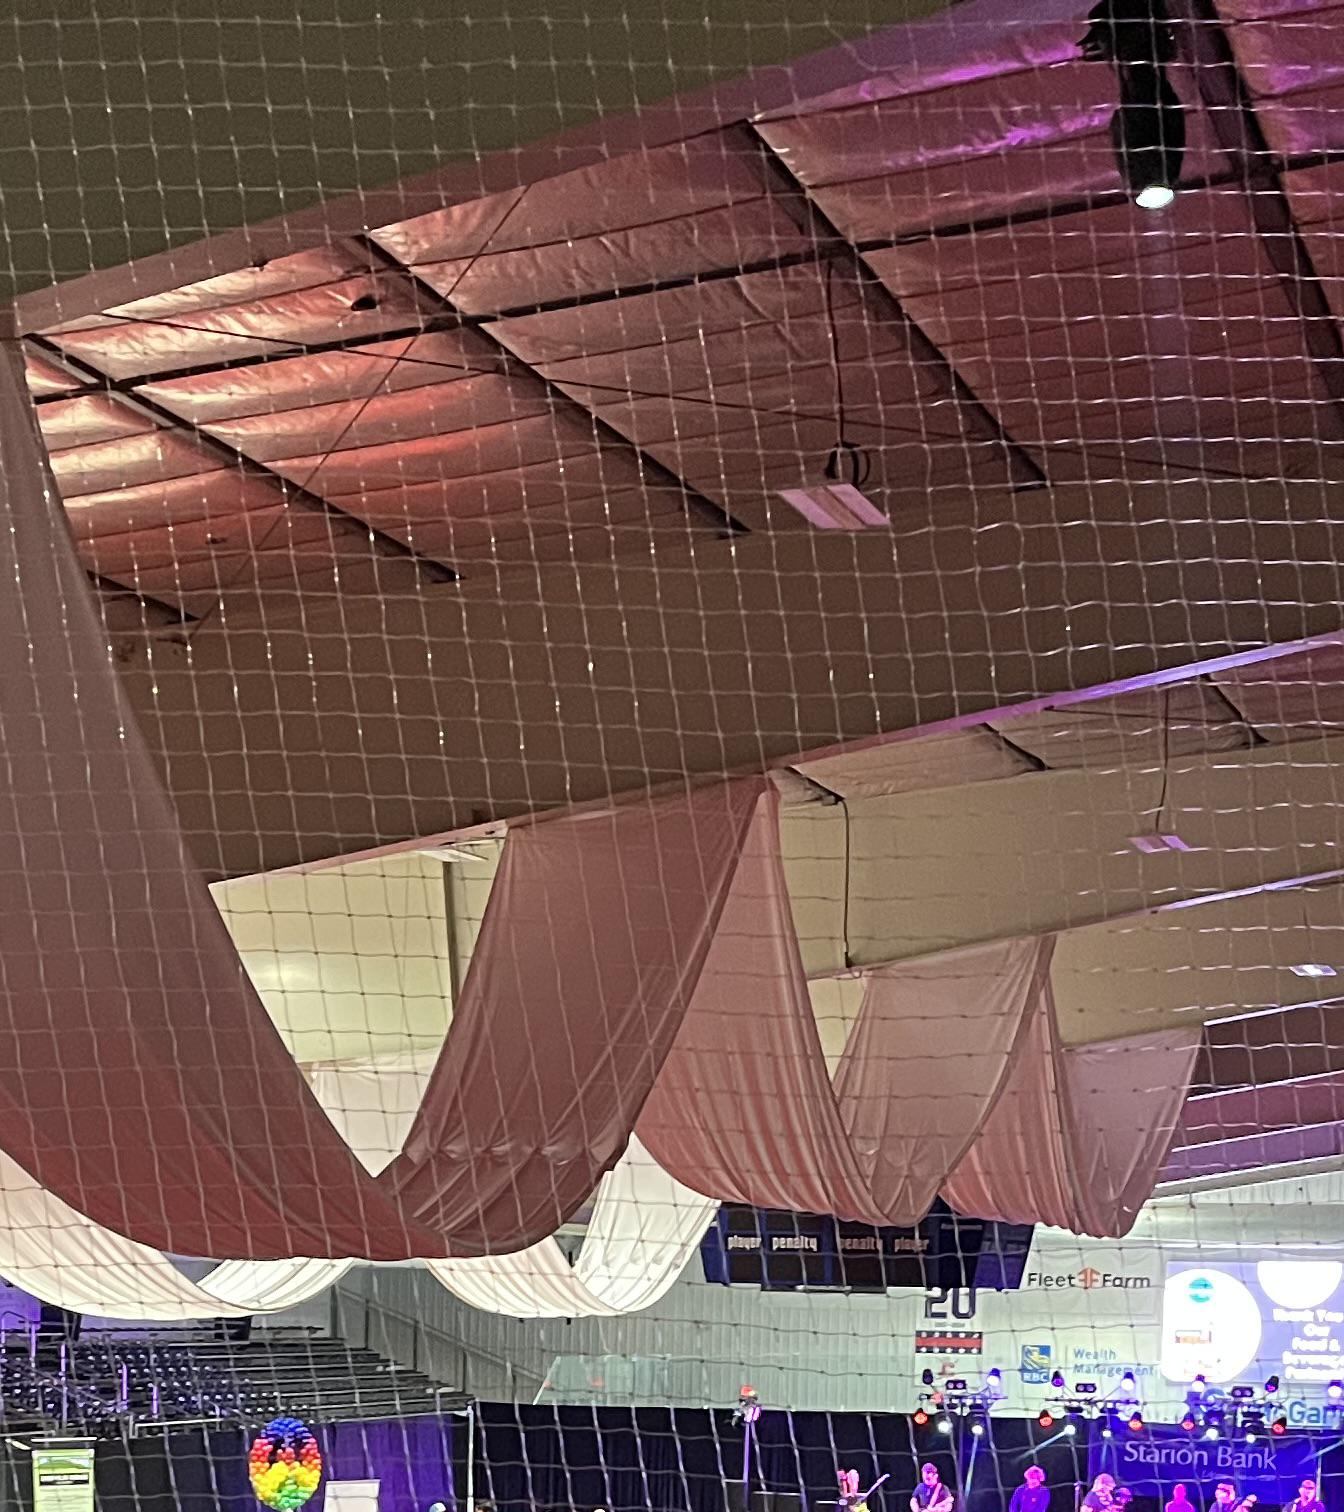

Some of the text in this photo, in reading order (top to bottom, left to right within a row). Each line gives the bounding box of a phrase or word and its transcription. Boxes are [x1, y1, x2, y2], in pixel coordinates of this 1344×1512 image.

[727, 1235, 817, 1251] player penalty
[839, 1236, 930, 1251] penalty player
[1027, 1273, 1150, 1288] Fleet Farm
[925, 1287, 976, 1319] 20
[1073, 1349, 1117, 1360] Wealth
[1022, 1372, 1049, 1383] RBC
[1072, 1364, 1155, 1378] Management
[1124, 1440, 1277, 1471] Starion Bank
